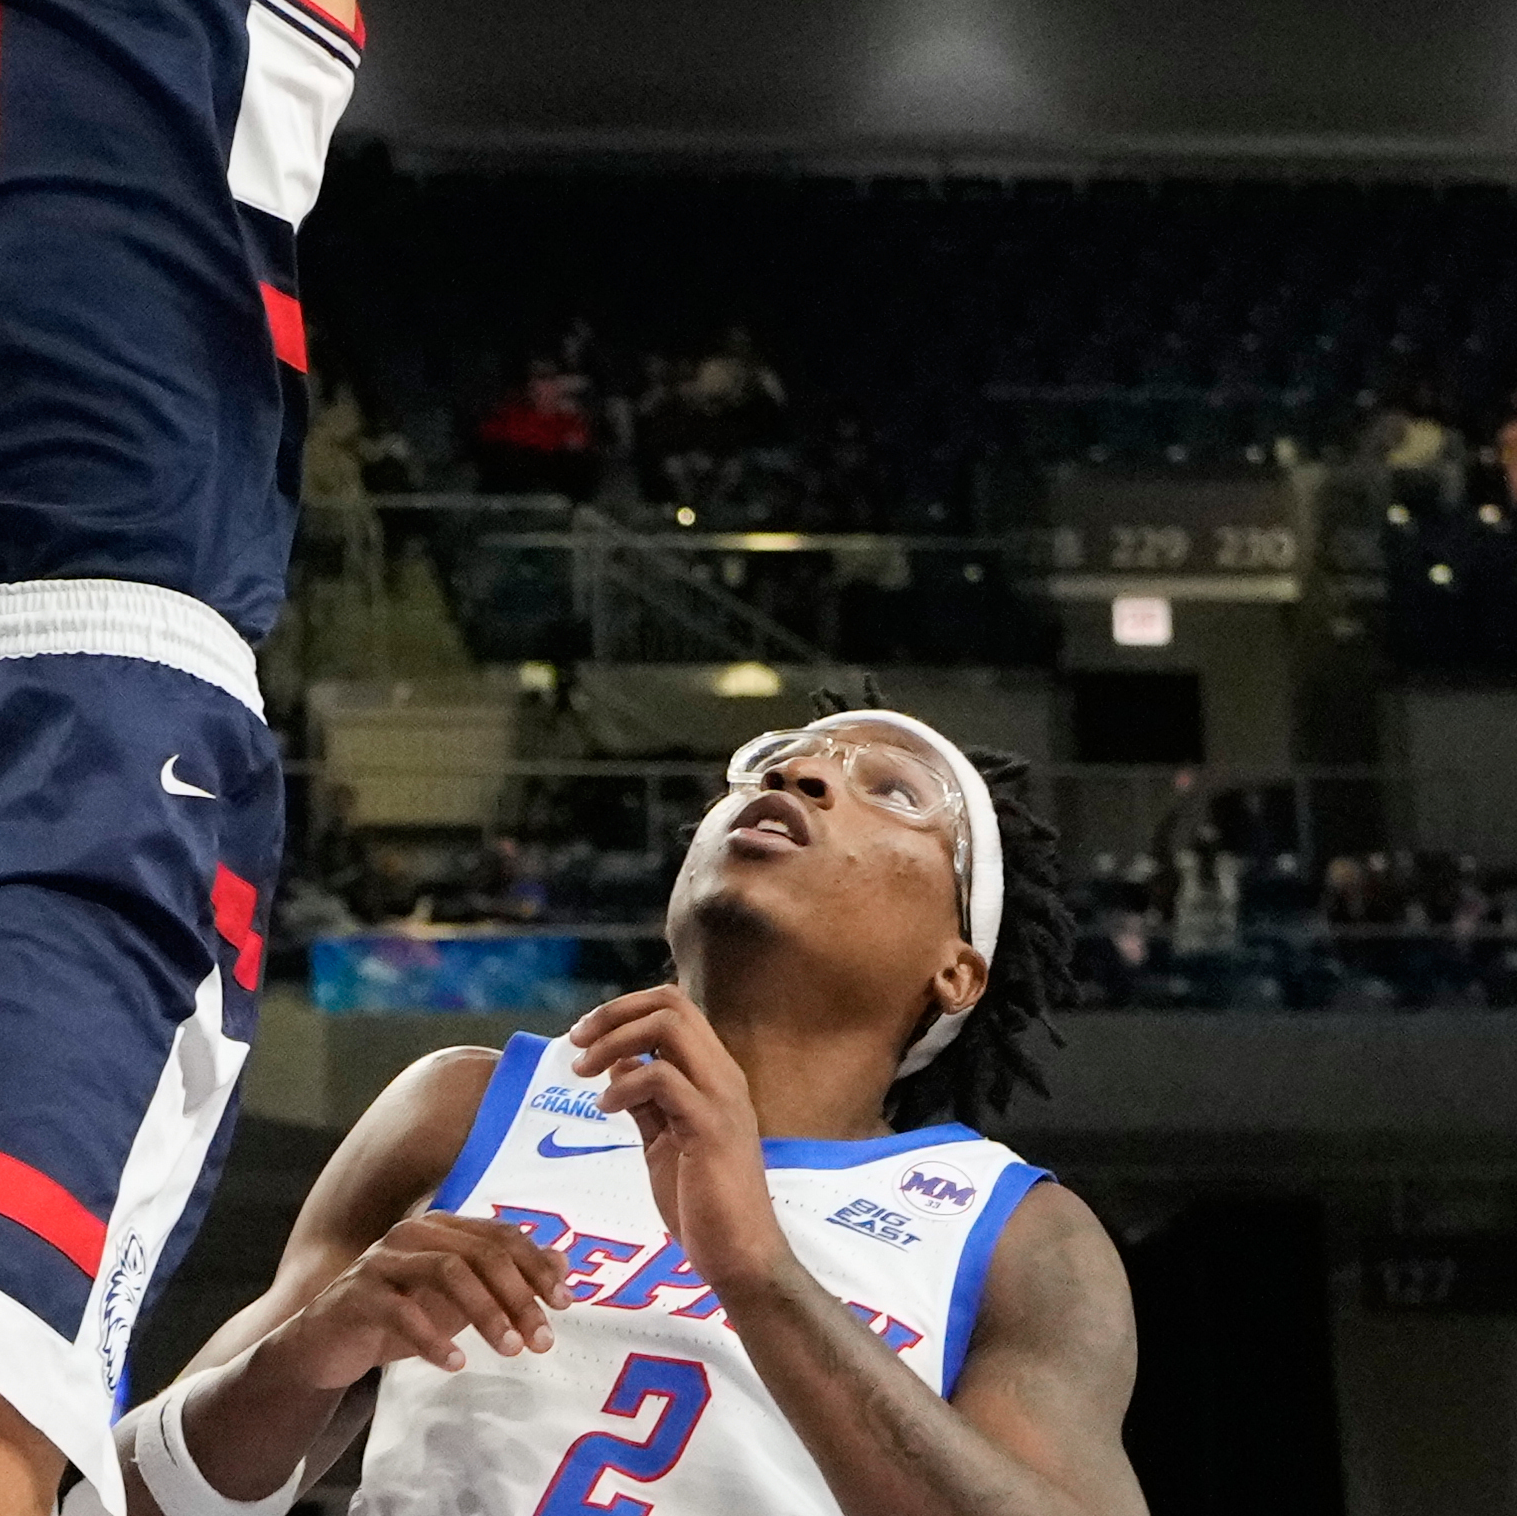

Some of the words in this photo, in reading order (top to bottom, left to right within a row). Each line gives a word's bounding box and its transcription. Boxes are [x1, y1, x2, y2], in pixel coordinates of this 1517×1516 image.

[899, 1170, 978, 1207] MM
[832, 1206, 923, 1247] EAST
[848, 1198, 912, 1227] BIG
